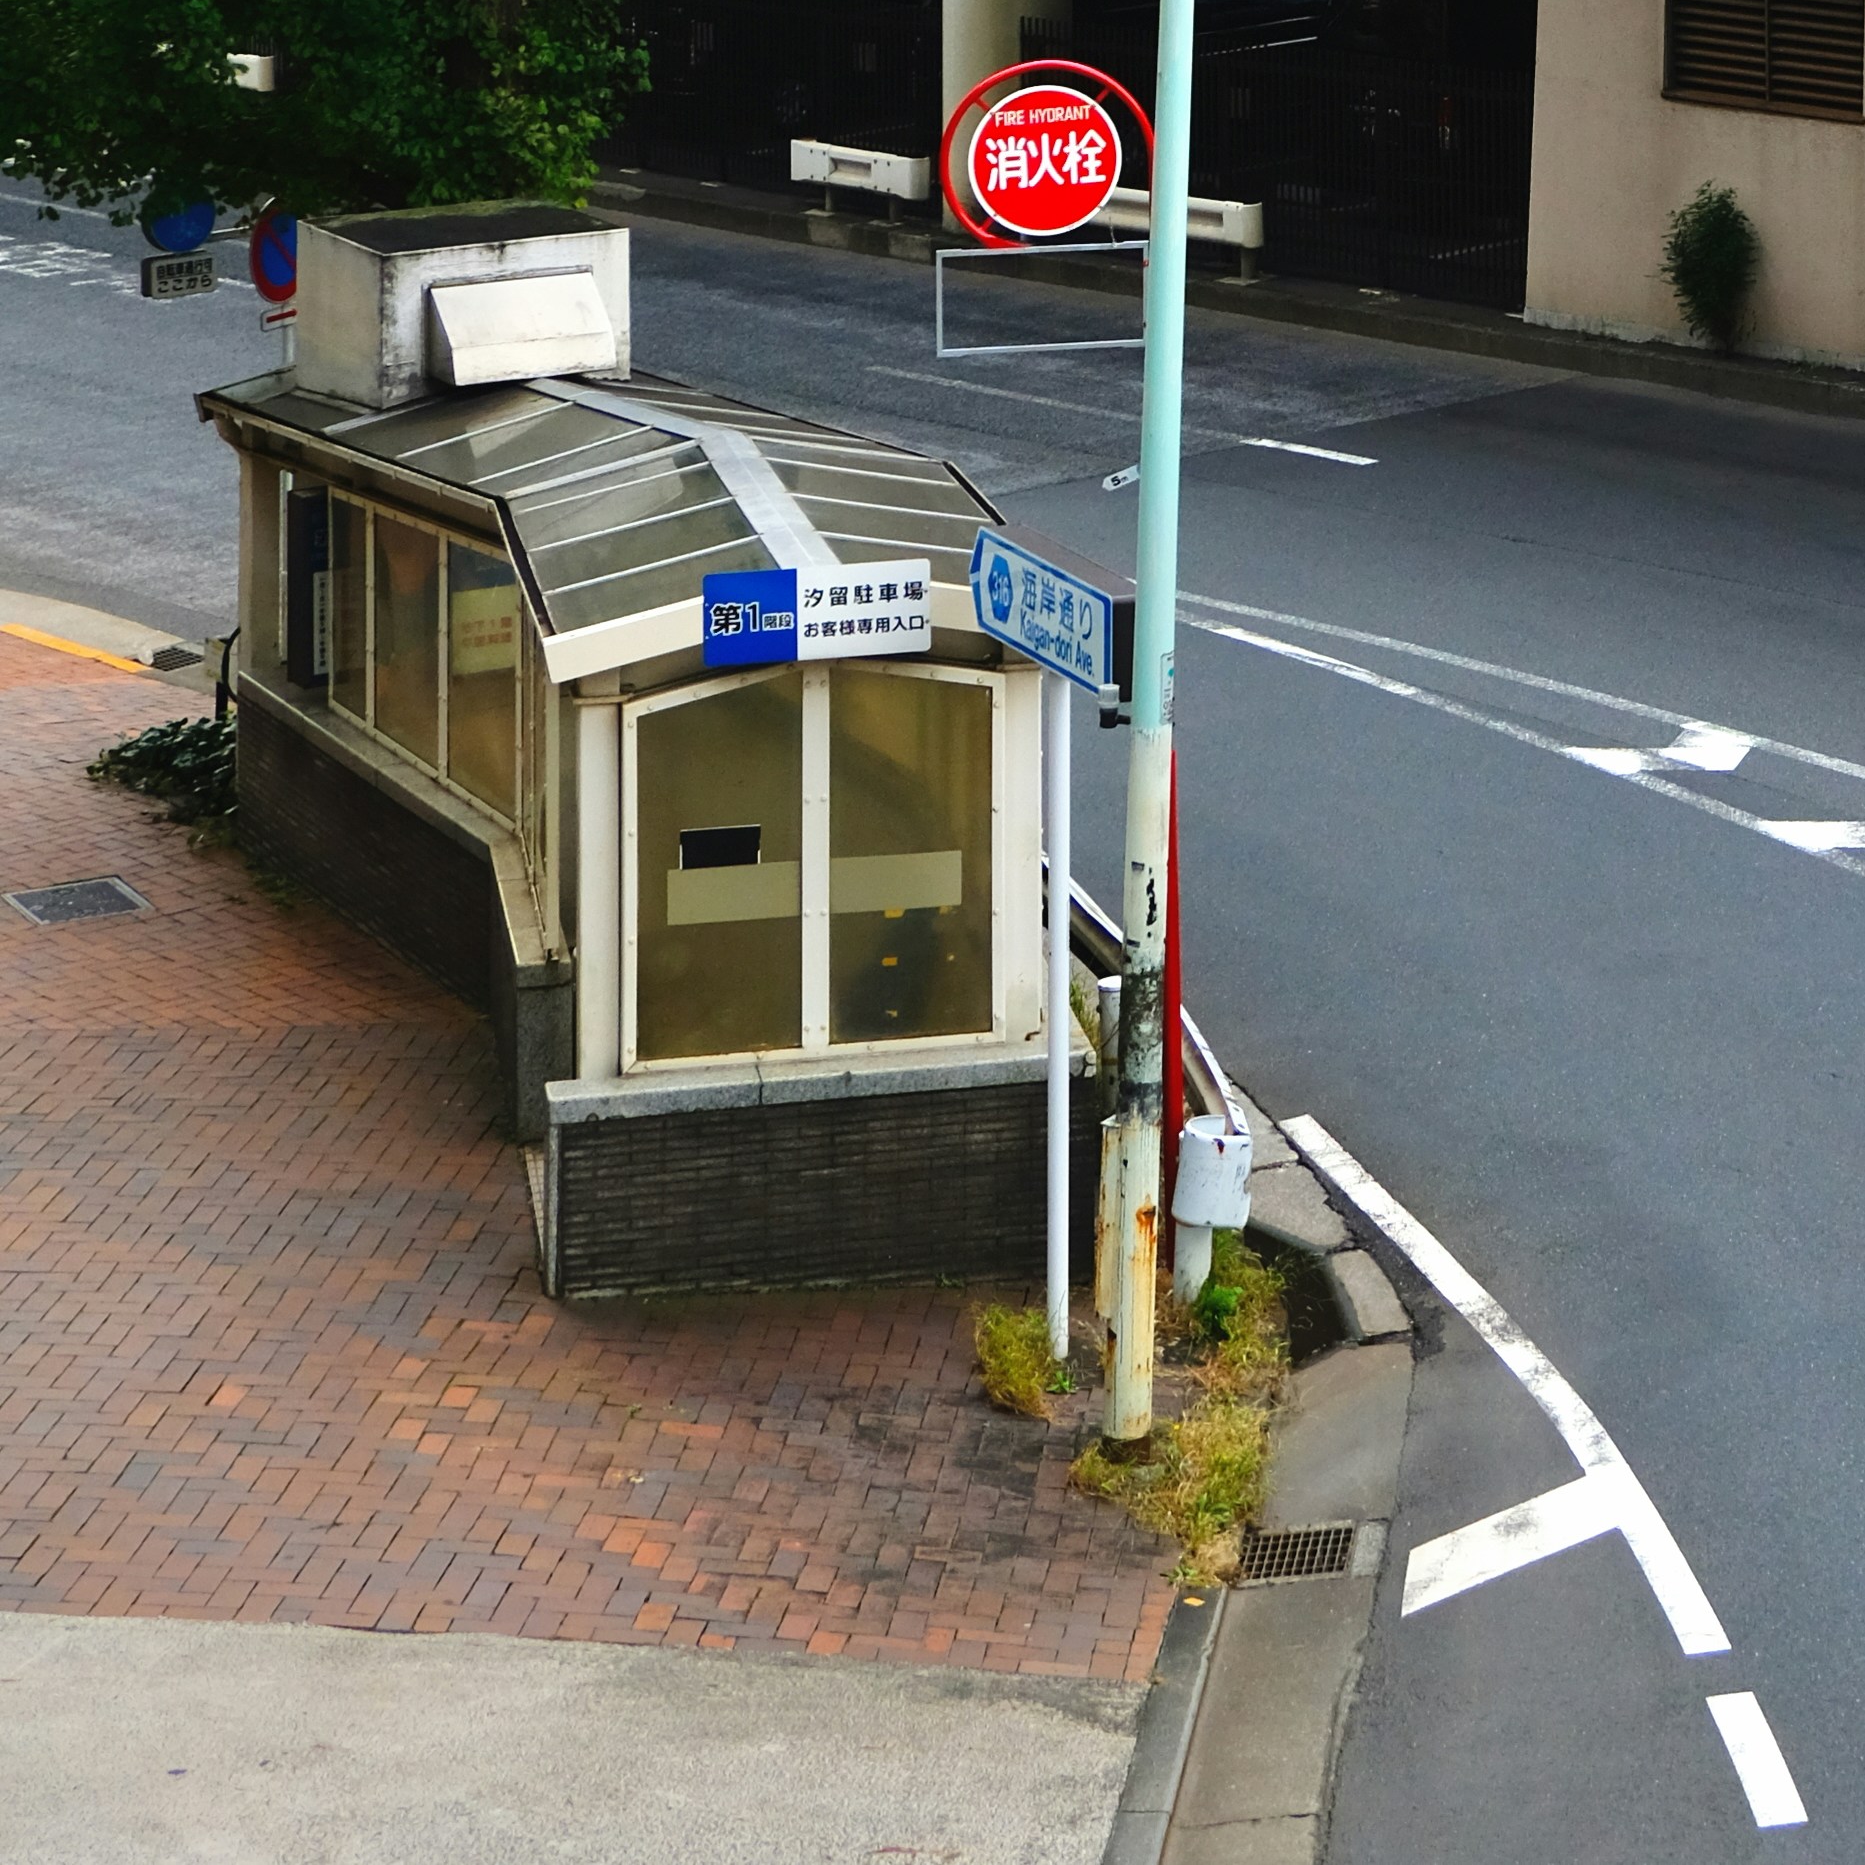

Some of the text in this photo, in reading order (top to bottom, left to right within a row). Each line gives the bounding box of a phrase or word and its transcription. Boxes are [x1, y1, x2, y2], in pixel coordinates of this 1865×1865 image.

[995, 104, 1092, 127] FIRE HYDRANT
[985, 129, 1107, 191] 消火栓
[158, 274, 212, 293] ここから
[803, 581, 923, 608] 汐留駐車場
[991, 571, 1011, 607] 316
[1021, 566, 1093, 640] 海岸通り
[711, 602, 794, 636] 第1階段
[803, 615, 925, 638] お客様専用入口
[1020, 608, 1094, 677] Kaigan-dori Ave.
